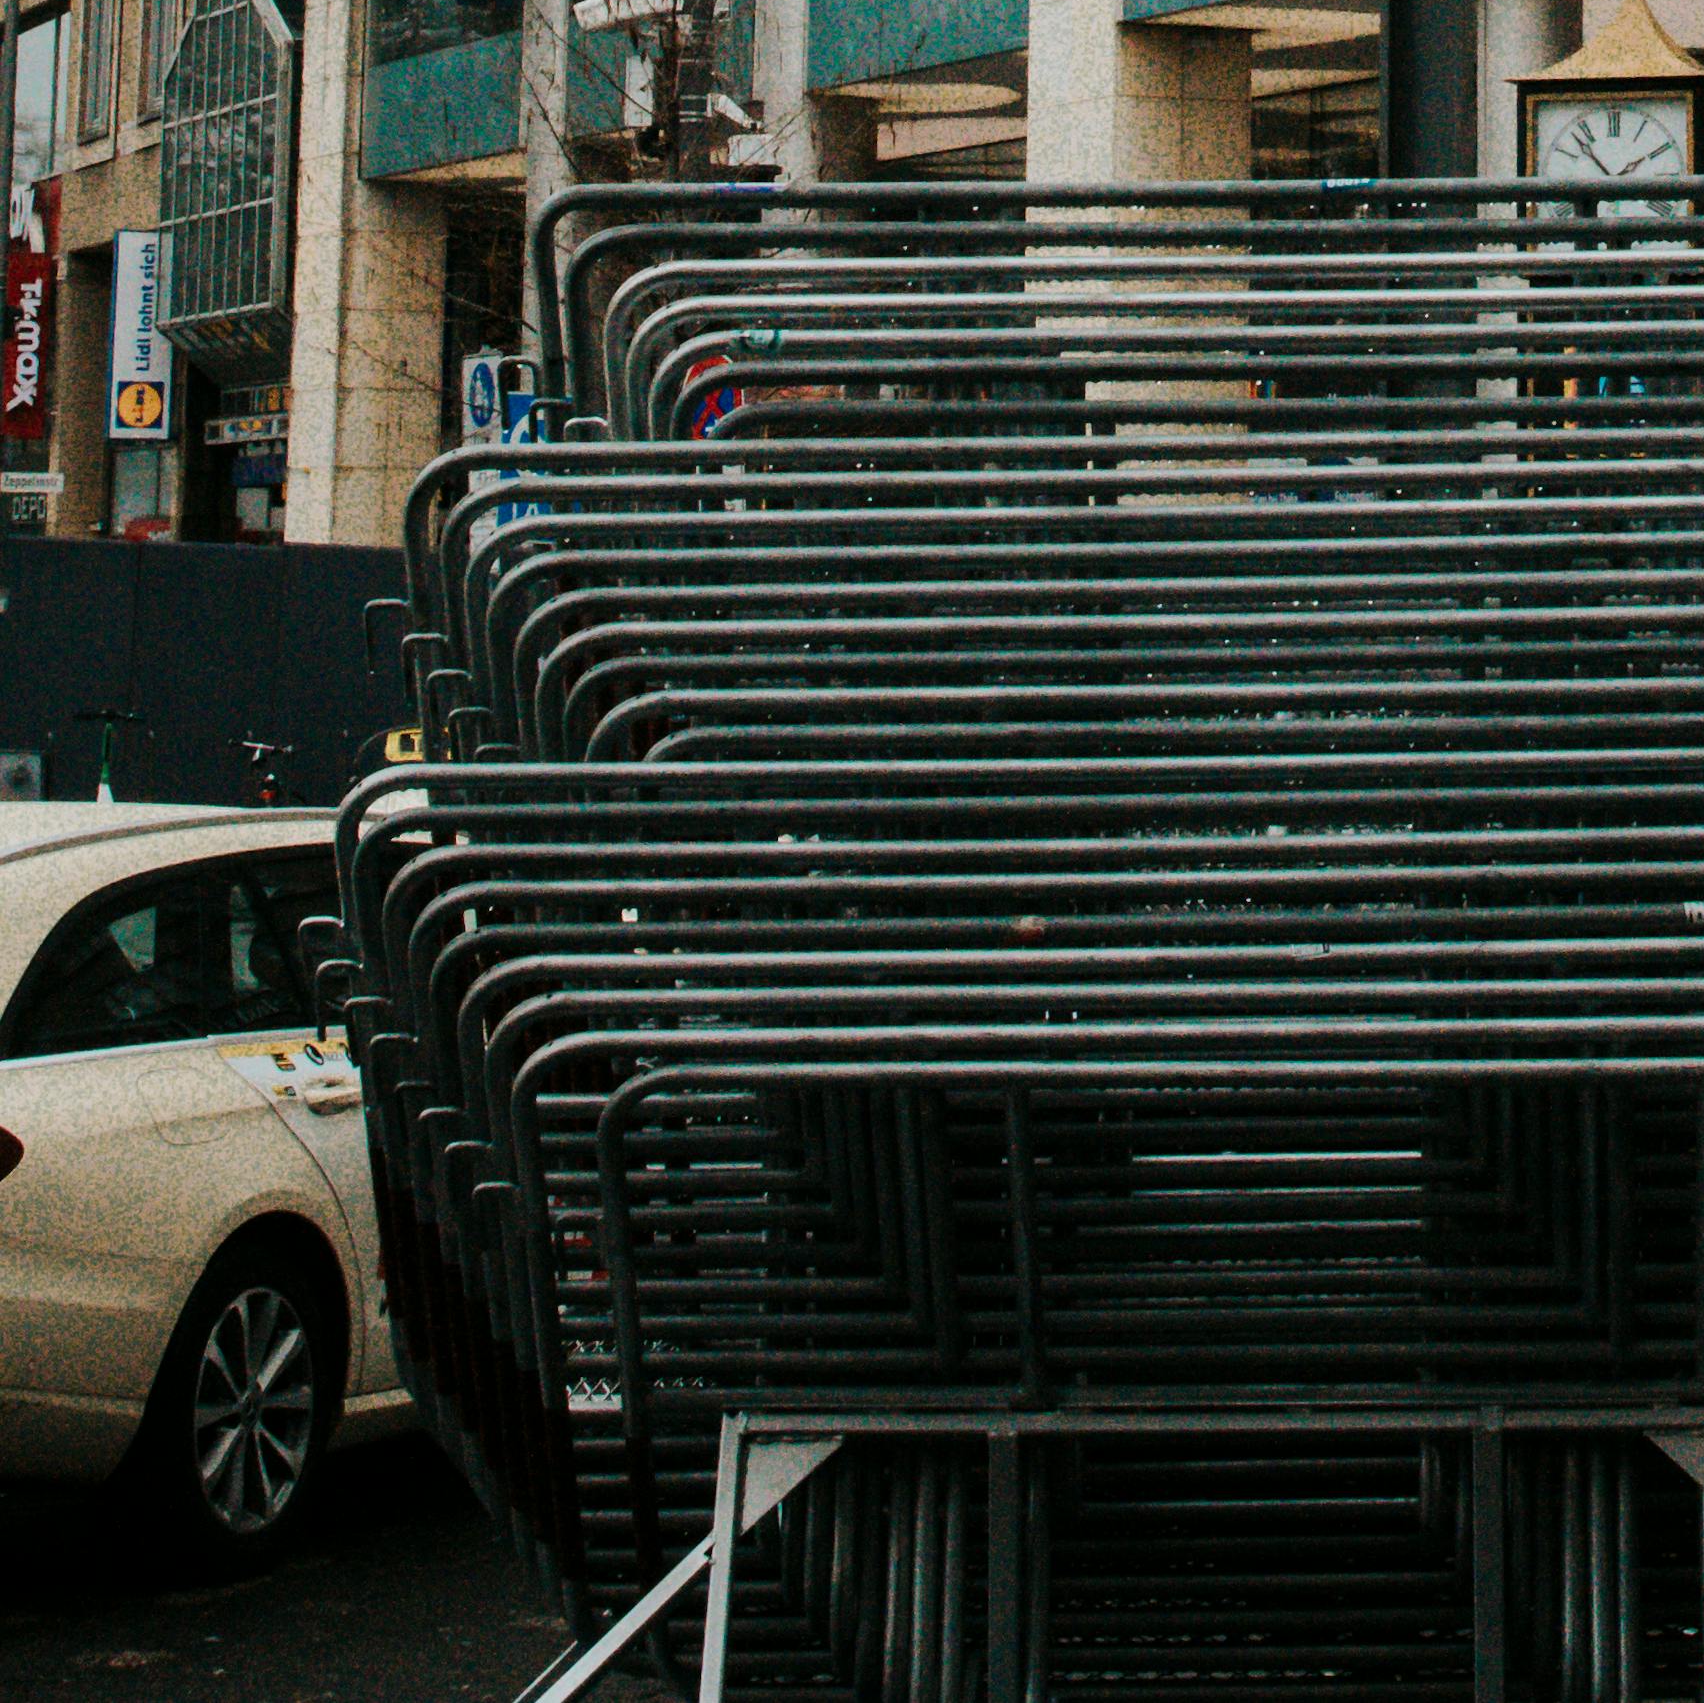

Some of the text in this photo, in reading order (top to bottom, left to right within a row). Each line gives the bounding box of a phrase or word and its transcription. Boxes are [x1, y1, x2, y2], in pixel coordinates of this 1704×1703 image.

[136, 243, 156, 371] Lidl lohnt sich
[11, 496, 47, 520] DEPO
